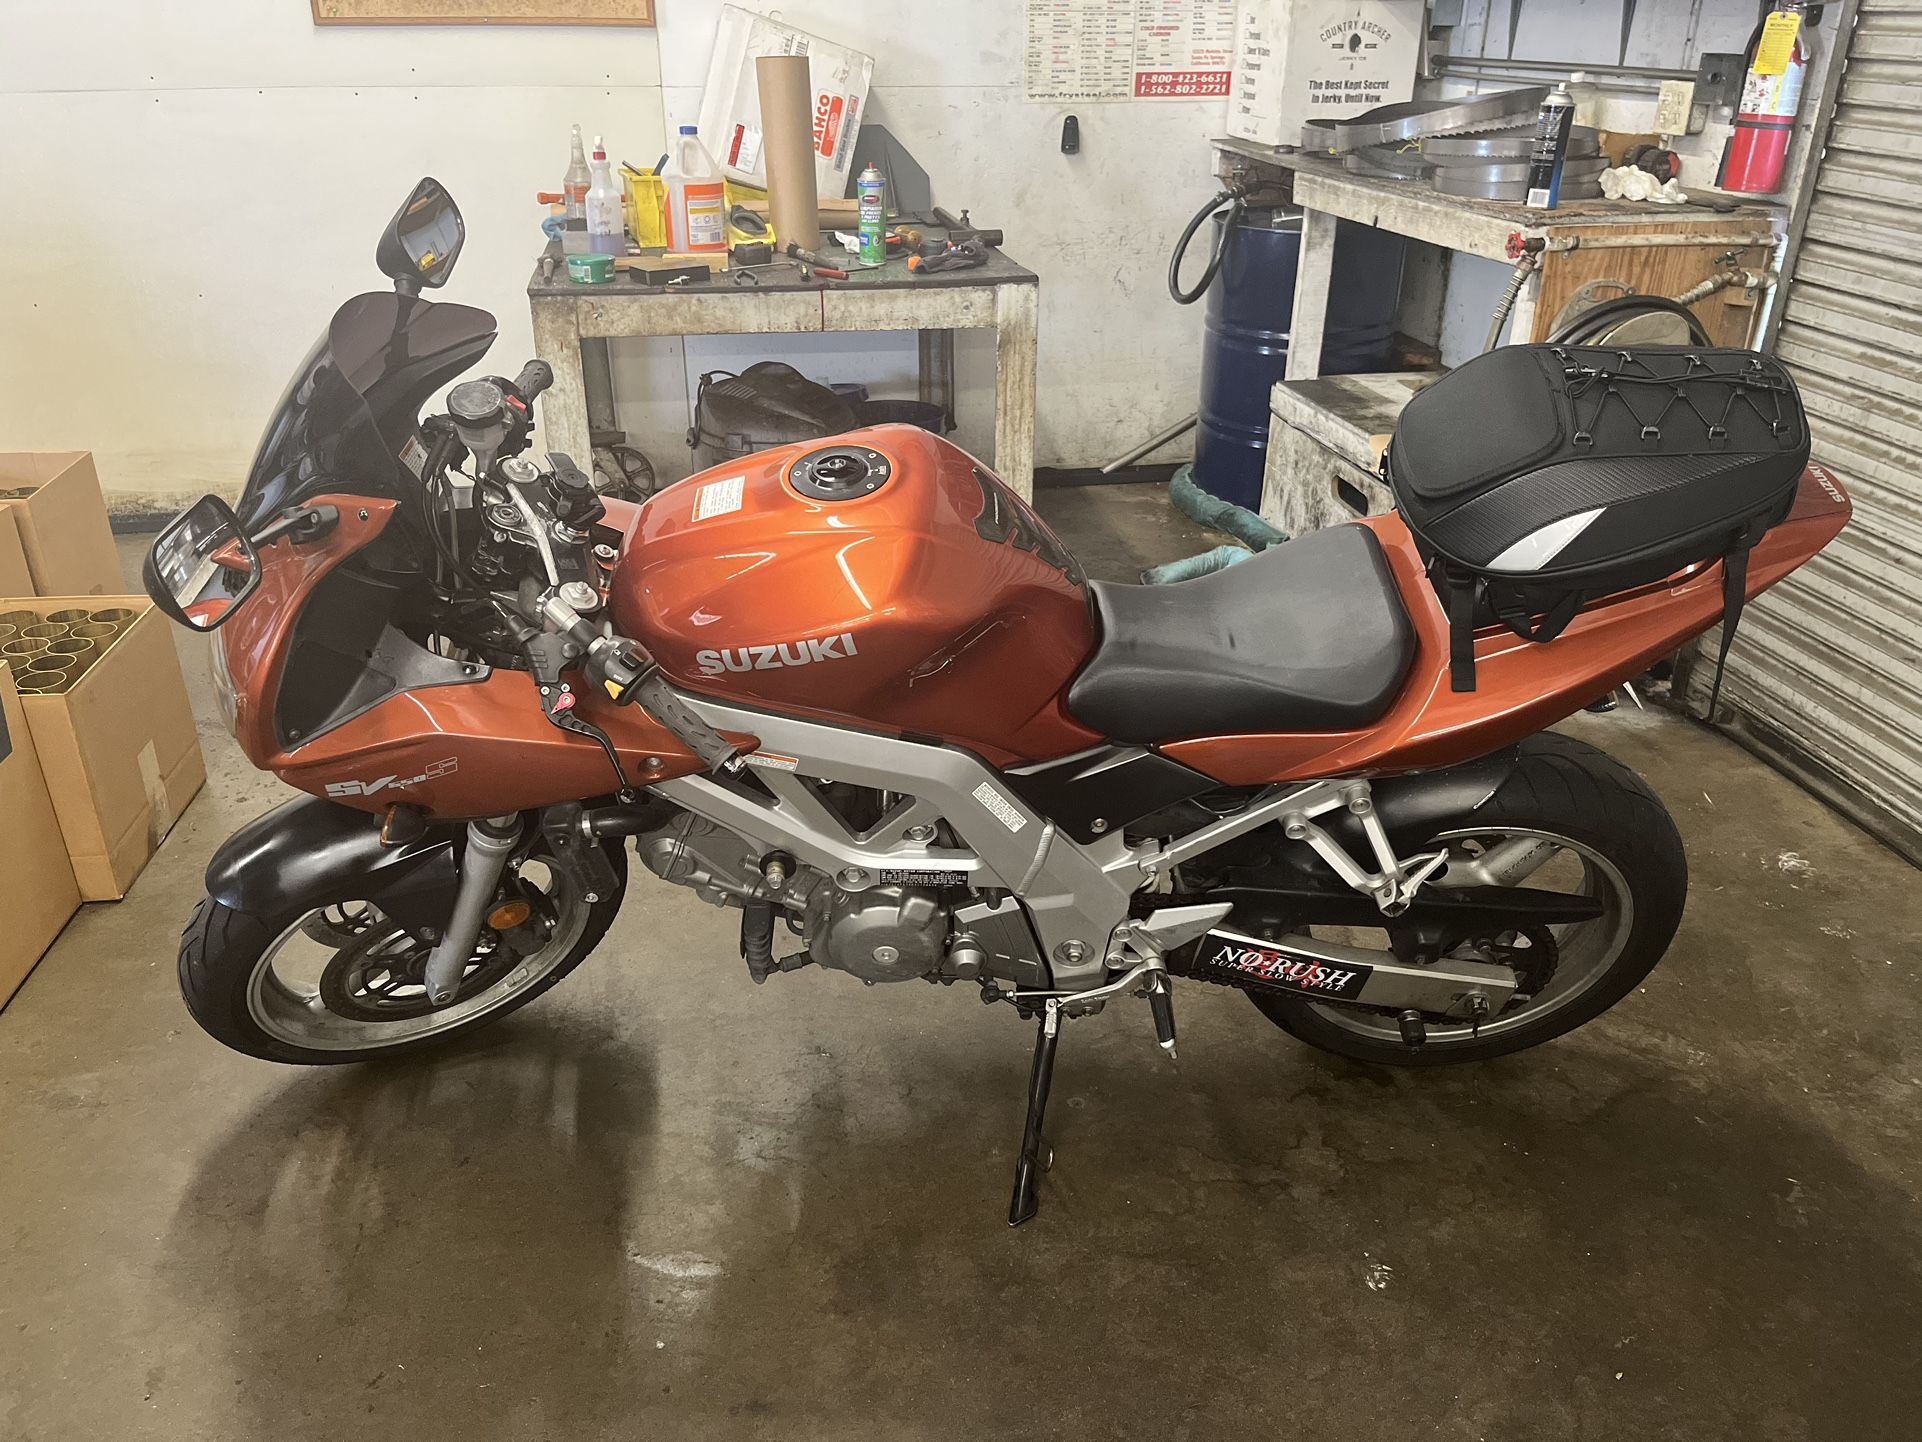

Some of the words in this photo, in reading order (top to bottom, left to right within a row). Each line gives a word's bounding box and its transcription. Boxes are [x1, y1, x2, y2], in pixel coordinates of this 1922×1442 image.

[1319, 20, 1358, 42] COUNTRY
[1361, 20, 1391, 42] ARCHER
[1141, 73, 1228, 83] 1-800-423-6651
[1140, 84, 1227, 94] 1-562-802-2721
[1309, 80, 1323, 90] The
[1324, 80, 1342, 90] Best
[1344, 80, 1362, 90] Kept
[1363, 80, 1389, 90] Secret
[1027, 91, 1129, 101] www.frysteel.com
[1311, 94, 1320, 103] In
[1321, 94, 1342, 104] Jerky.
[1344, 94, 1363, 103] Until
[1365, 94, 1382, 103] Now.
[1807, 465, 1846, 503] SUZUKI
[696, 633, 858, 675] SUZUKI
[1209, 957, 1255, 973] SUPER
[1257, 968, 1298, 982] SLOW
[1300, 978, 1346, 992] STYLE
